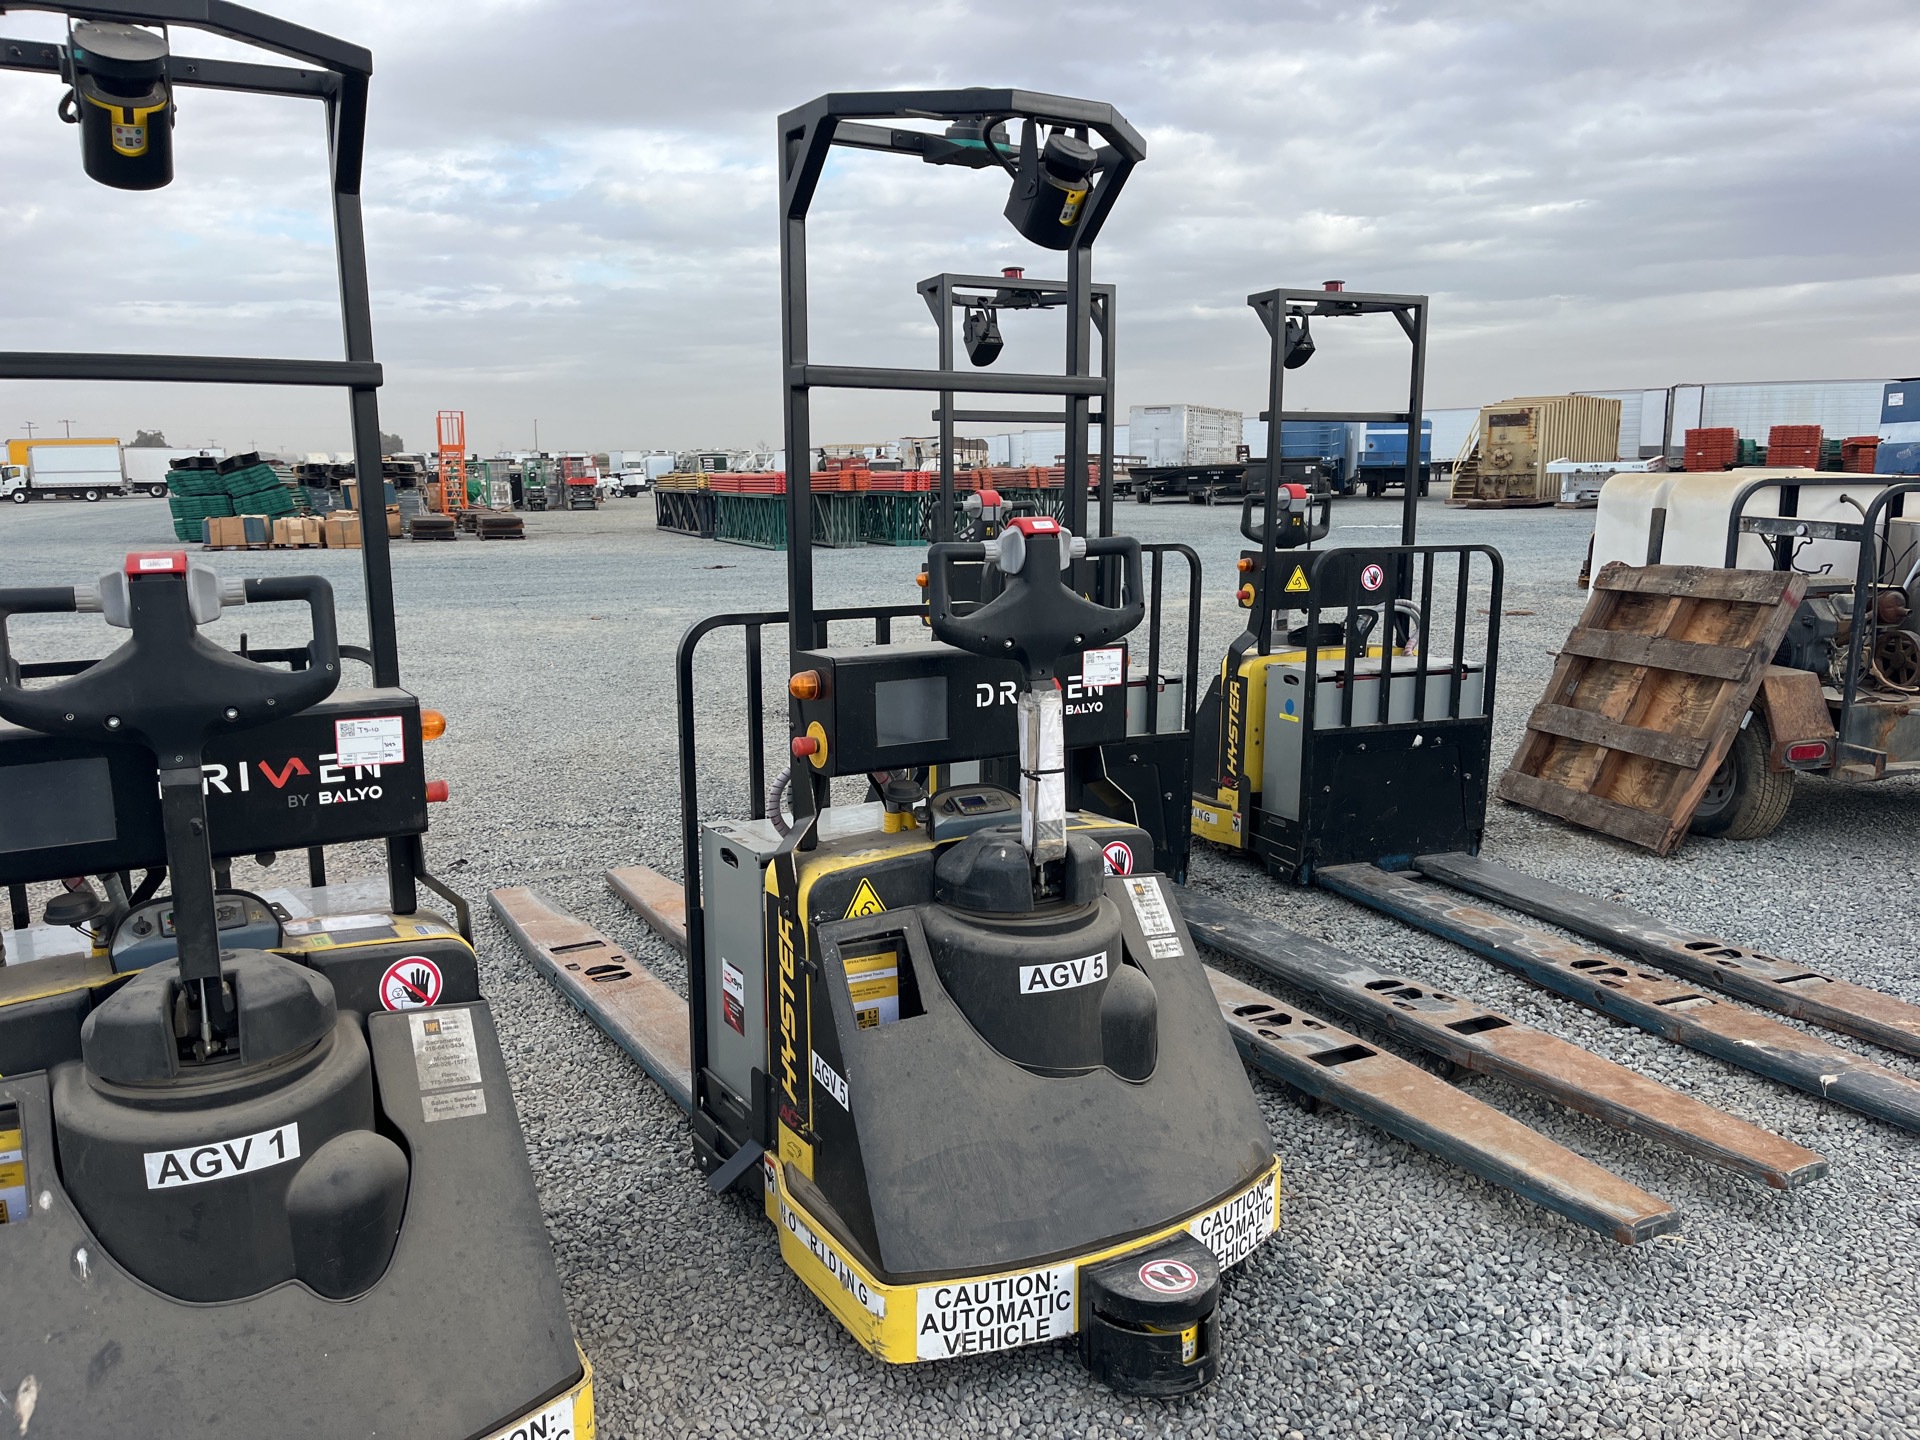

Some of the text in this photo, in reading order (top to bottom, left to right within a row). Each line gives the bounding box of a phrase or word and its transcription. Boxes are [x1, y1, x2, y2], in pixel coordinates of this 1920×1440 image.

[1065, 701, 1103, 715] BALYO
[1226, 681, 1240, 776] HYSTER
[288, 785, 383, 808] BY BALYO
[1028, 955, 1103, 990] AGV 5
[778, 911, 797, 1105] HYSTER
[425, 1037, 462, 1046] Sacramento
[814, 1056, 846, 1105] AGV 5
[431, 1098, 448, 1106] Sales
[434, 1105, 454, 1113] Rental
[158, 1129, 285, 1185] AGV 1
[1204, 1196, 1272, 1252] UTOMATIC
[1217, 1223, 1263, 1269] EHICLE
[810, 1233, 868, 1306] RIDING
[935, 1271, 1059, 1309] CAUTION:
[920, 1290, 1071, 1335] AUTOMATIC
[943, 1317, 1050, 1355] VEHICLE
